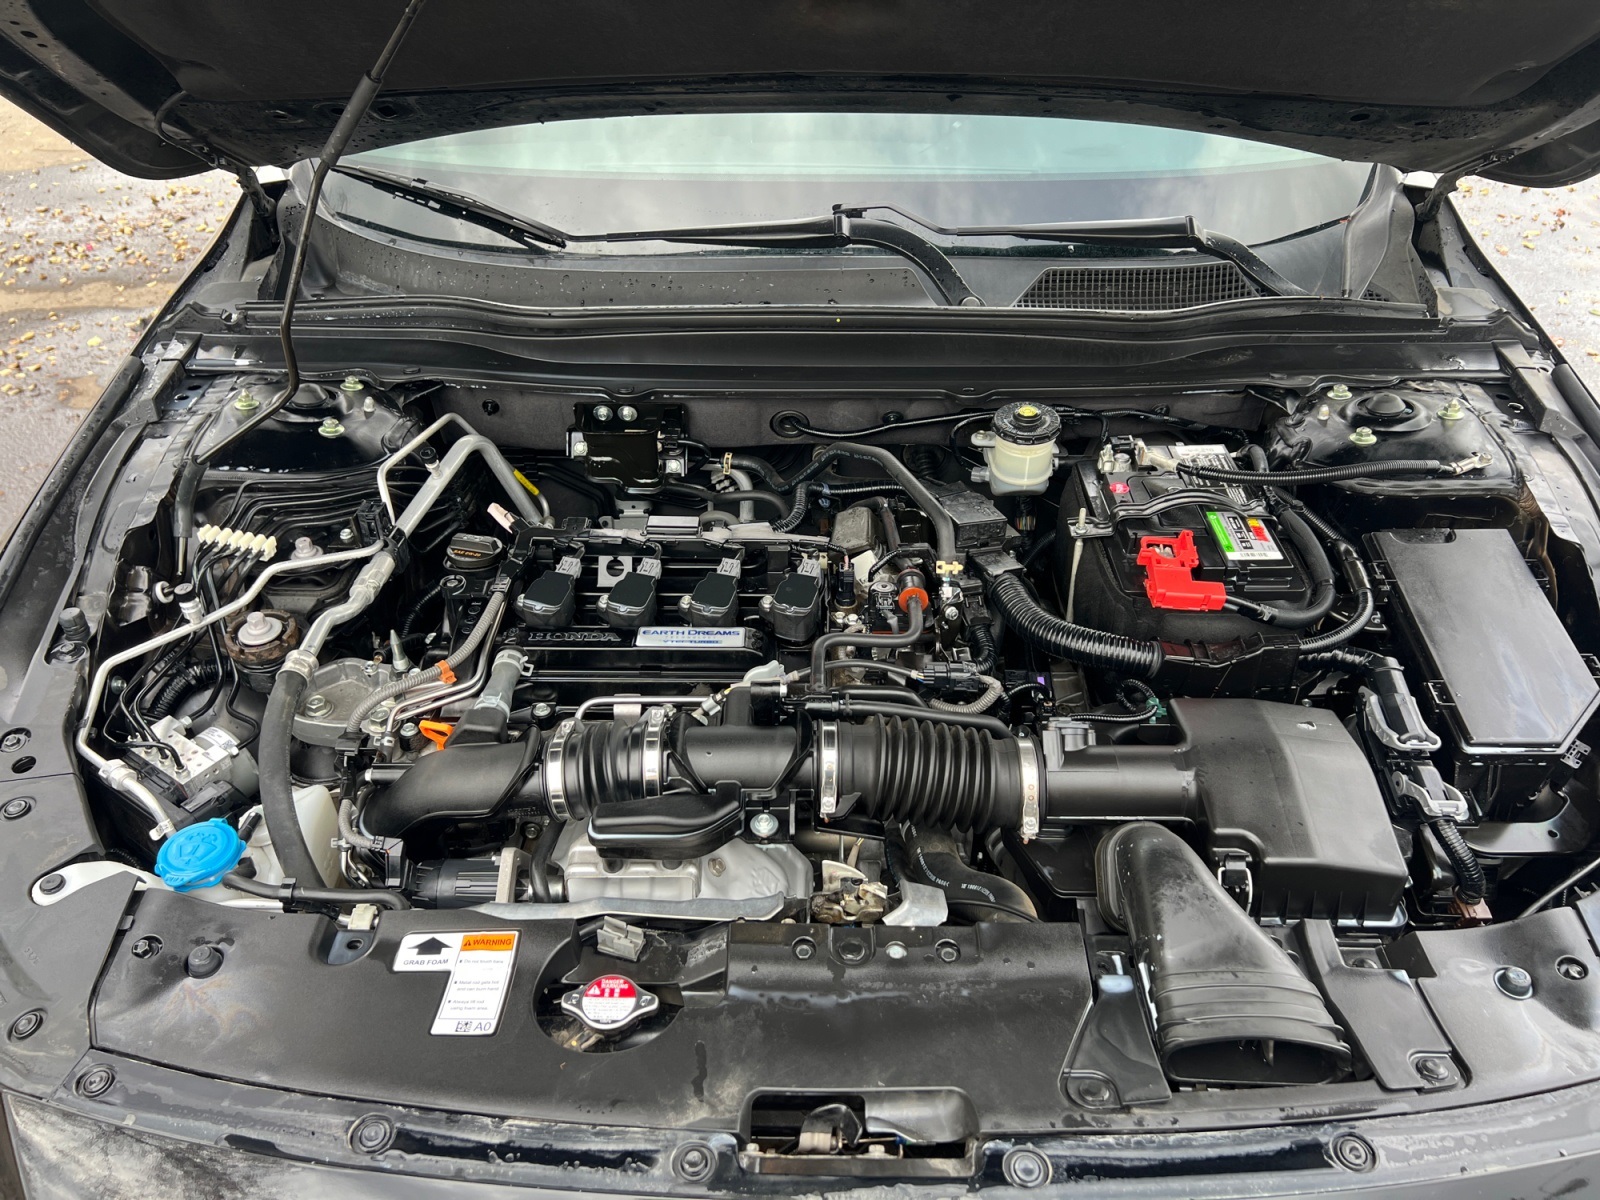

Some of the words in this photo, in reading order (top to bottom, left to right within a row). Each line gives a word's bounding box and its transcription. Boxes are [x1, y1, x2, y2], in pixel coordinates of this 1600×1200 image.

[528, 632, 622, 642] HONDA
[473, 938, 512, 946] WARNING
[473, 1022, 492, 1032] A0
